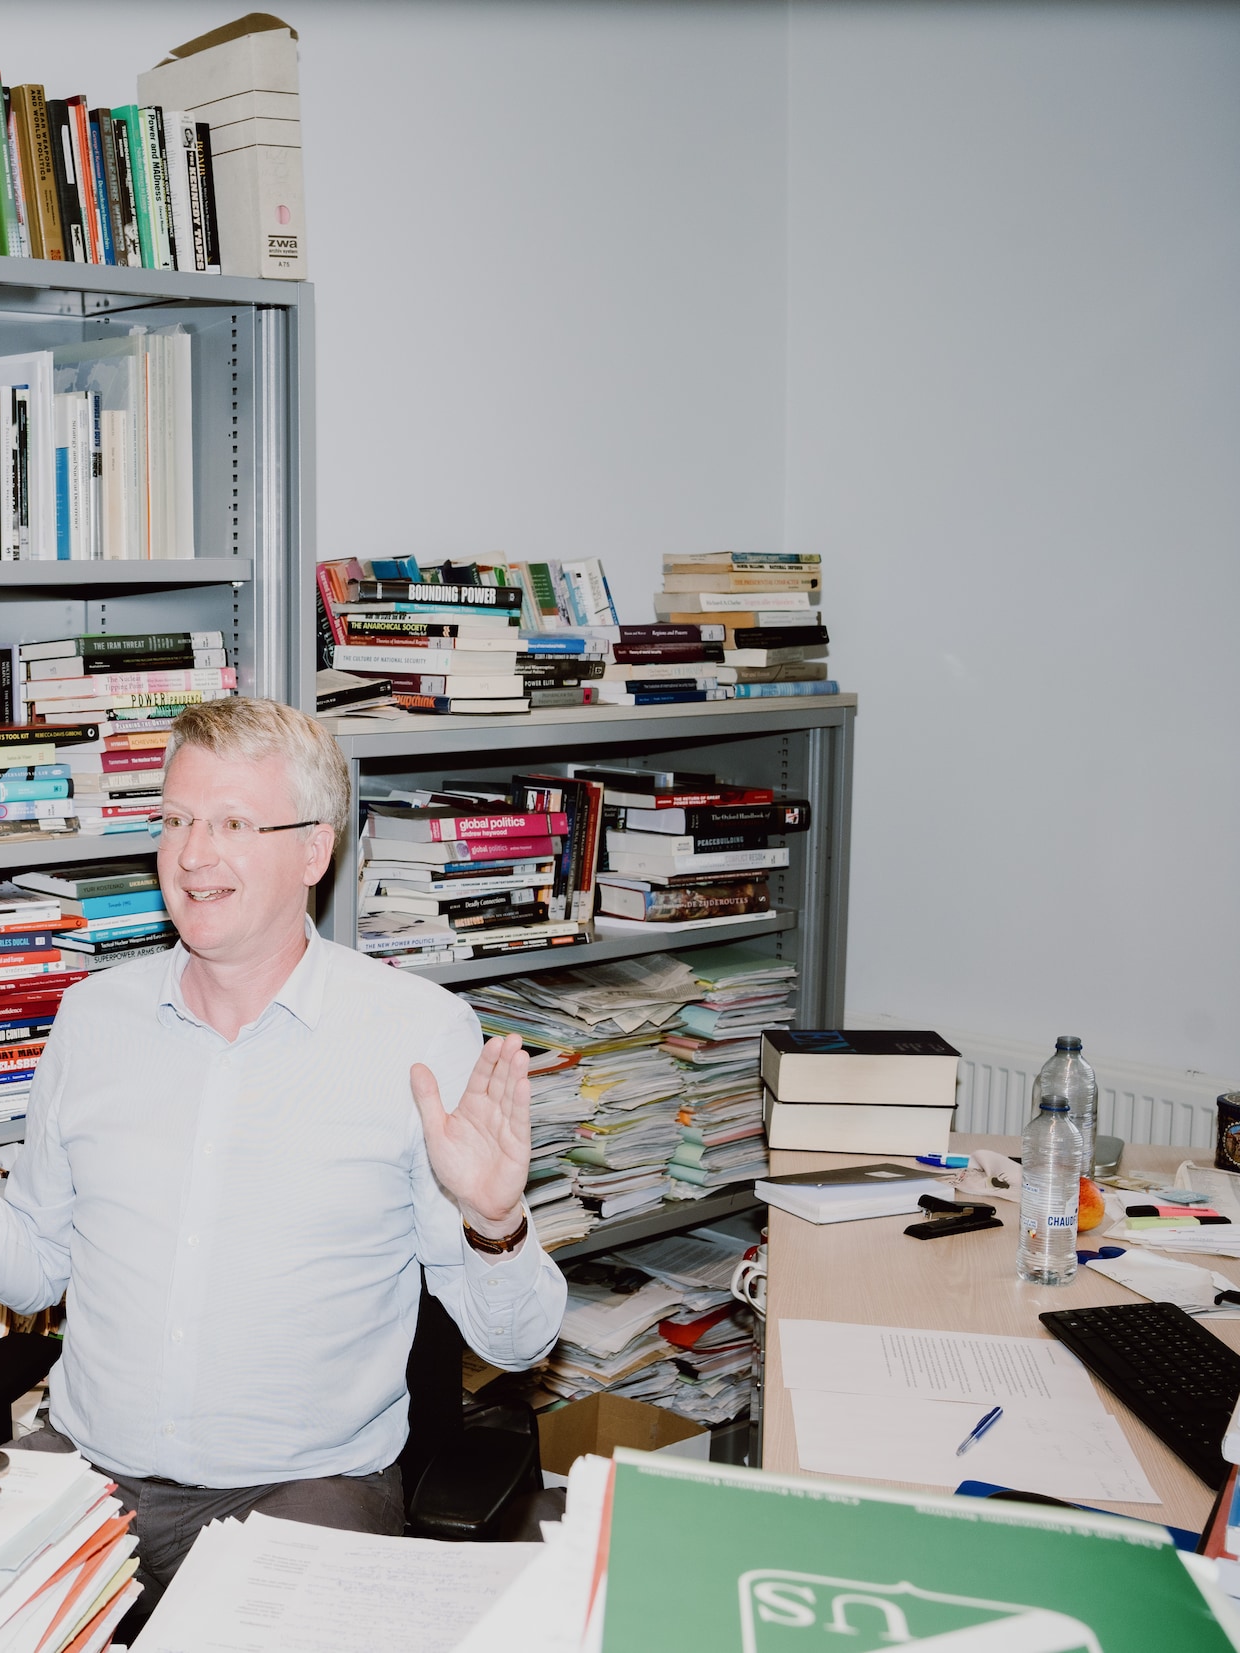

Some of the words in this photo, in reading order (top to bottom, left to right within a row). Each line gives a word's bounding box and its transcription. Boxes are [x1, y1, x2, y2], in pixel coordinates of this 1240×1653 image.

[33, 109, 42, 140] WORLD
[148, 114, 156, 141] Power
[36, 89, 45, 127] NUCLEAR
[41, 128, 52, 173] WEAPONS
[151, 143, 159, 161] and
[36, 142, 46, 181] POLITICS
[153, 162, 163, 202] MADness
[190, 166, 201, 227] KENNEDY
[269, 239, 298, 249] zwa
[194, 229, 206, 271] TAPES
[409, 584, 458, 602] BOUNDING
[460, 587, 497, 605] POWER
[351, 622, 362, 630] THE
[362, 622, 401, 631] ANARCHICAL
[123, 641, 145, 649] THREAT
[405, 657, 427, 665] SECURITY
[120, 675, 141, 683] Nuclear
[128, 682, 144, 690] Point
[131, 694, 166, 707] POWER
[6, 733, 20, 741] TOOL
[20, 732, 30, 740] KIT
[722, 813, 739, 821] Oxford
[460, 818, 489, 832] global
[490, 816, 526, 830] politics
[461, 829, 481, 837] andrew
[482, 828, 508, 837] heywood
[697, 836, 744, 847] PEACEBUILDING
[472, 844, 487, 854] global
[488, 844, 508, 853] politics
[97, 883, 125, 891] KOSTENKO
[465, 900, 481, 909] Deadly
[482, 896, 507, 907] Connections
[687, 900, 698, 908] DE
[699, 897, 749, 907] ZIJDEROUTES
[13, 938, 30, 946] DUCAL
[391, 940, 410, 948] POWER
[411, 938, 435, 946] POLITICS
[10, 955, 25, 963] Europe
[94, 952, 136, 964] SUPERPOWER
[137, 948, 155, 957] ARMS
[6, 1027, 31, 1041] CONTROL
